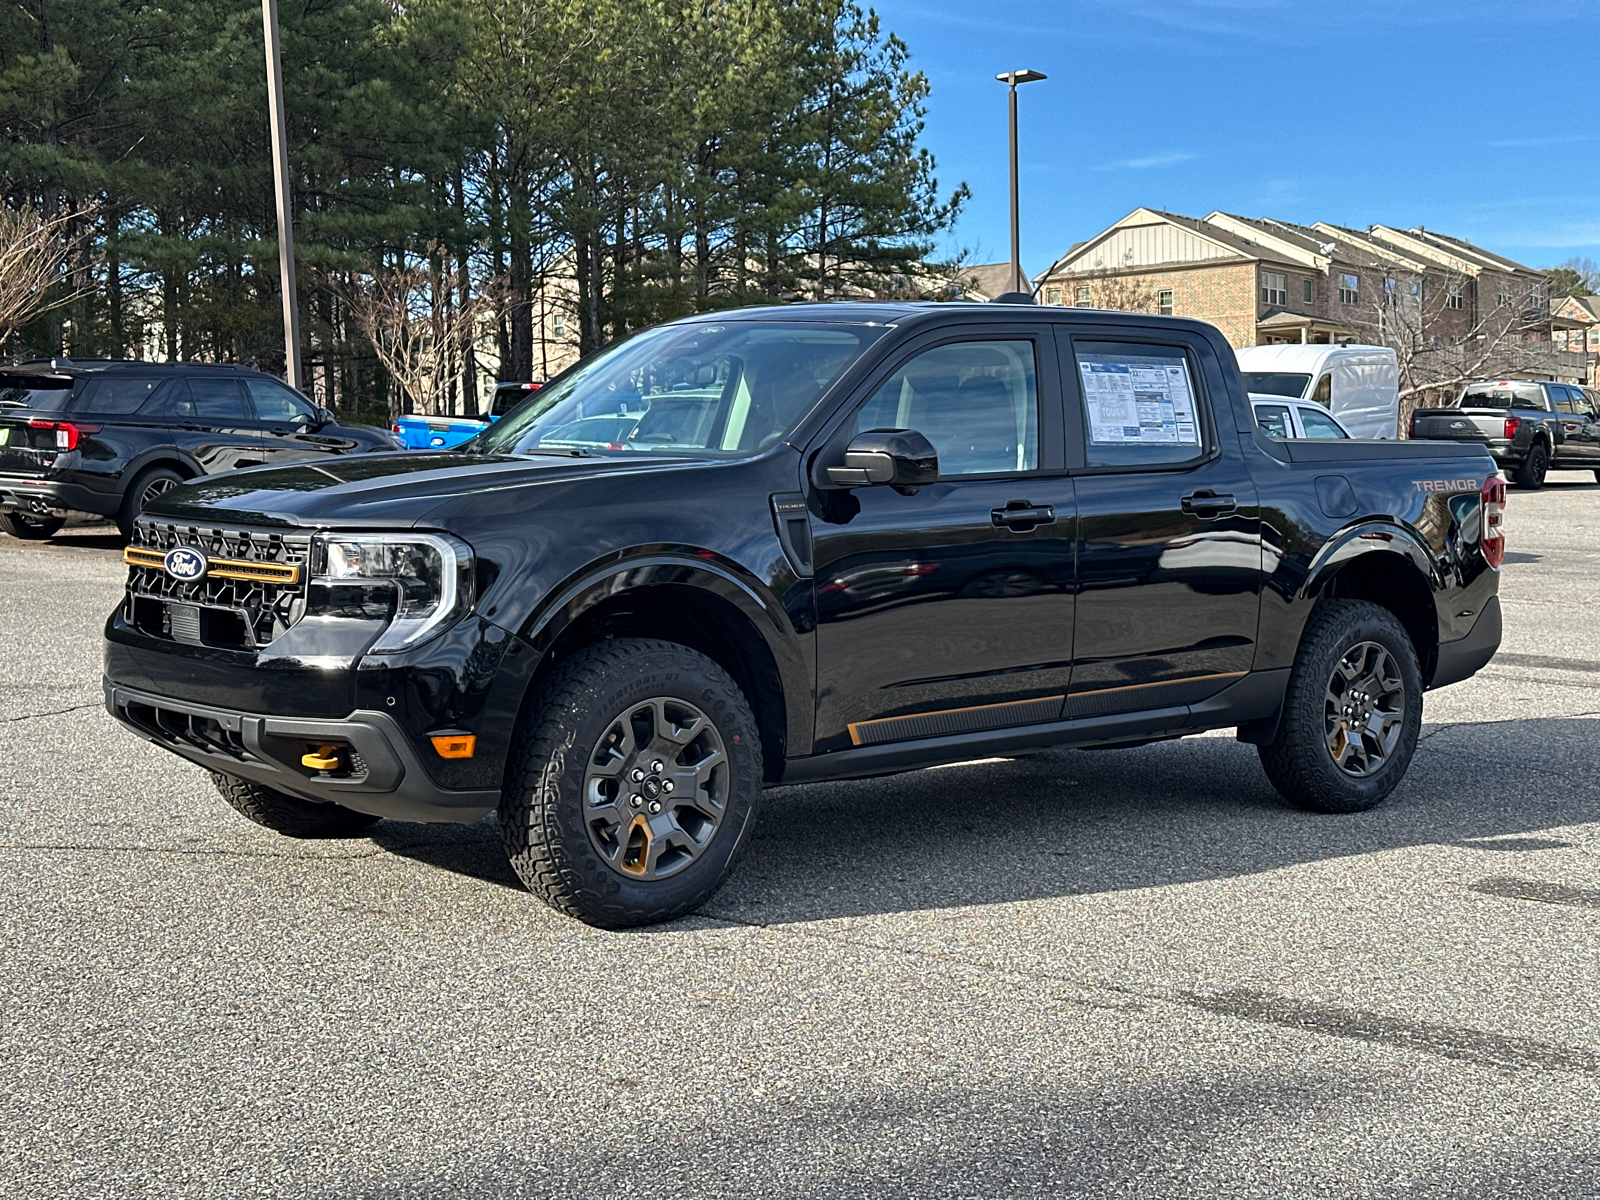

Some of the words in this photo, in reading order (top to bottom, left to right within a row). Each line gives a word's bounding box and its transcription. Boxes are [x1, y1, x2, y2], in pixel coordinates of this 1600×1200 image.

[1101, 407, 1126, 417] TOUGH
[1412, 479, 1478, 492] TREMOR
[665, 672, 681, 681] RT
